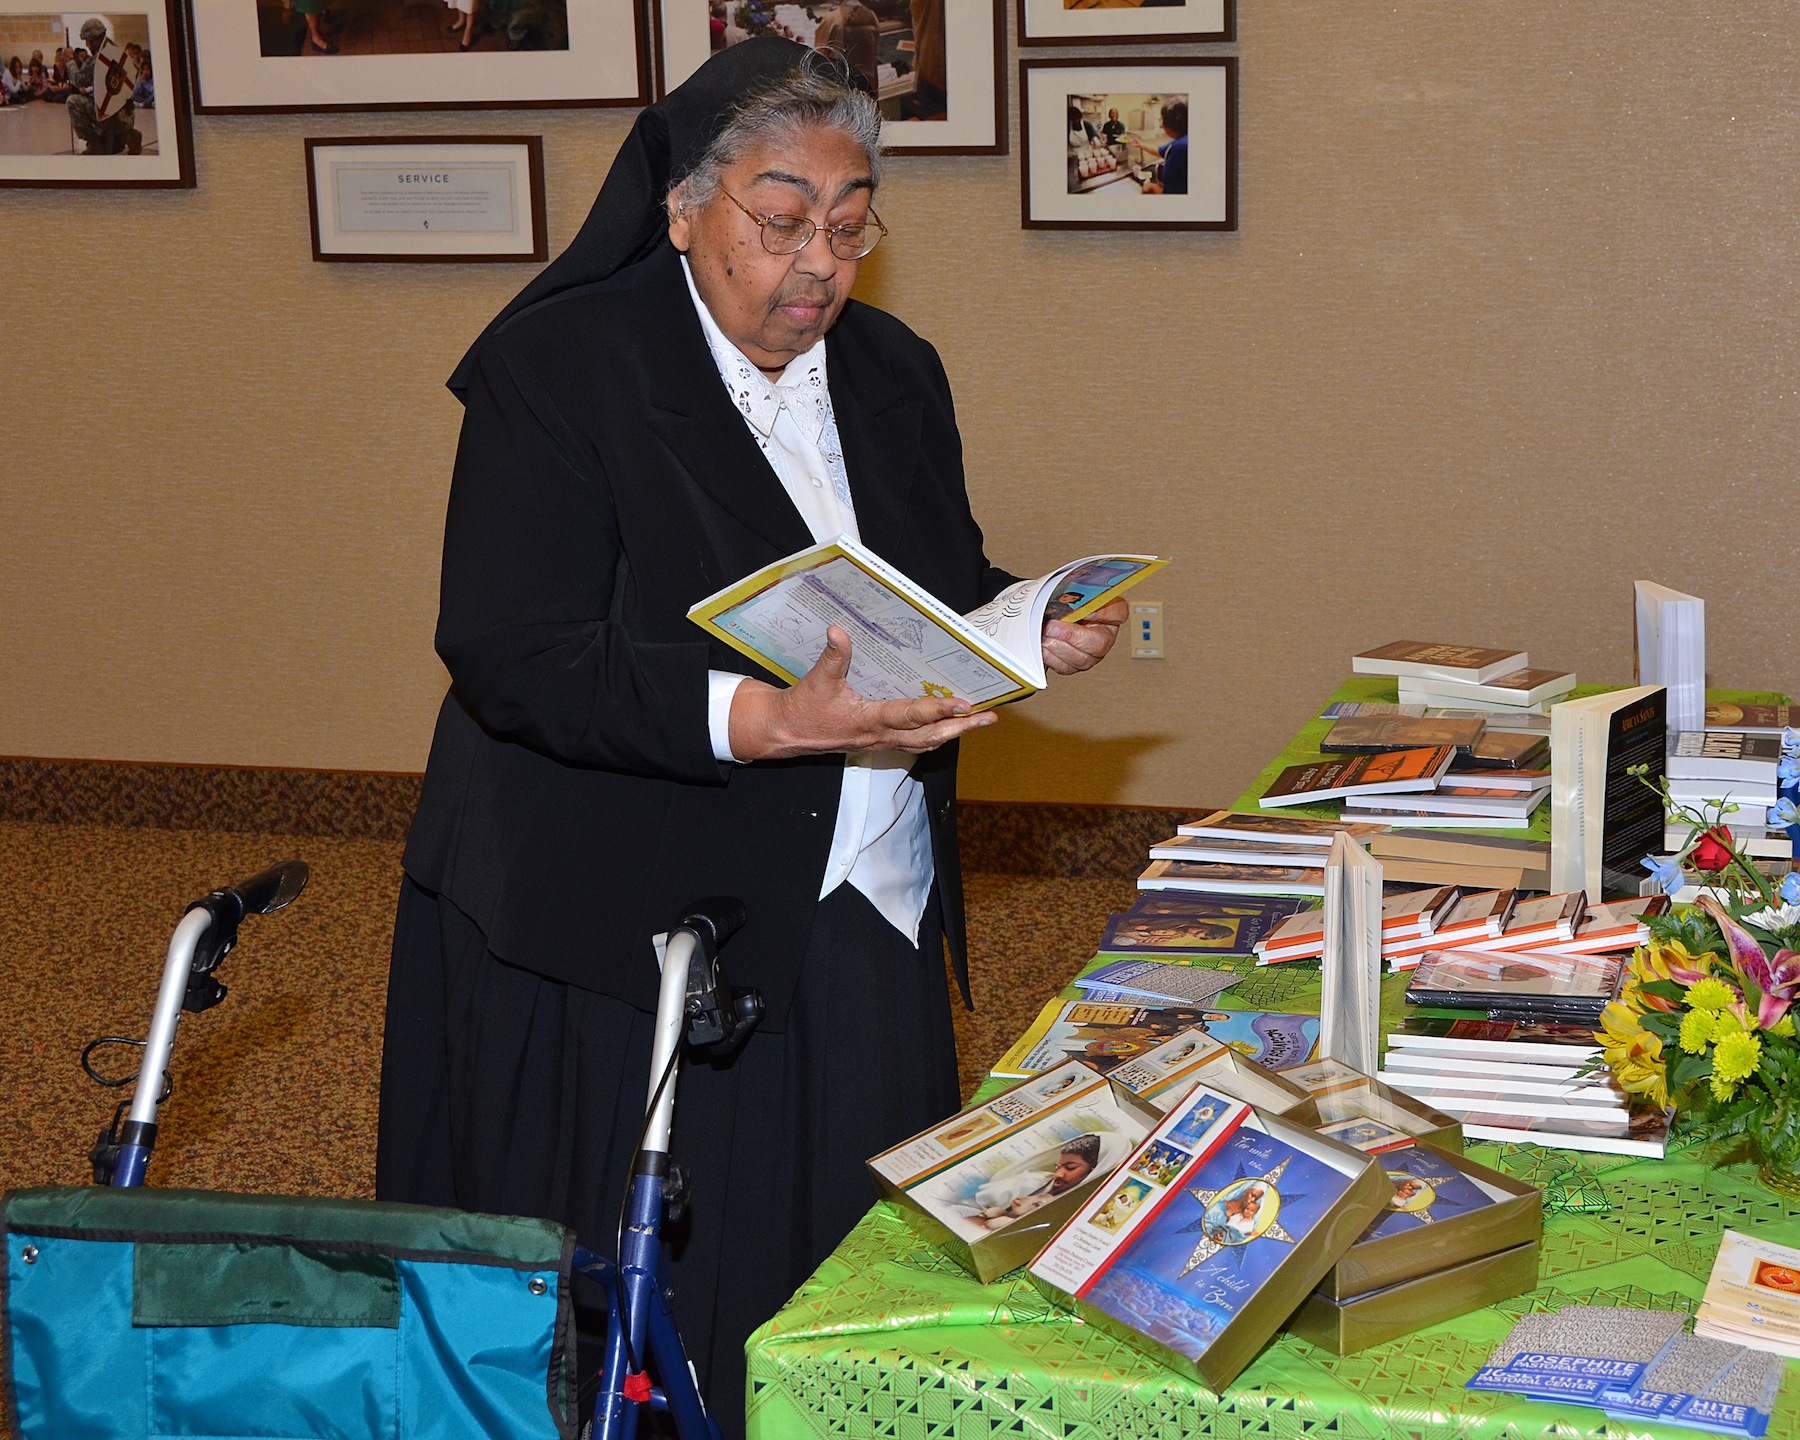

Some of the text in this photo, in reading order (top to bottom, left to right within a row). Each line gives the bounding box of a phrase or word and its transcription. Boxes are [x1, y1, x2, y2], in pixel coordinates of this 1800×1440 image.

[398, 174, 449, 183] SERVICE
[1702, 732, 1744, 758] BLACK
[1243, 931, 1259, 948] Joseph
[1234, 1136, 1272, 1159] For unto
[1197, 1263, 1250, 1292] A child
[1203, 1285, 1233, 1311] Born
[1513, 1359, 1633, 1378] PASTORAL CENTER
[1519, 1354, 1639, 1372] JOSEPHITE
[1476, 1373, 1597, 1391] PASTORAL CENTER
[1688, 1408, 1745, 1422] CENTER
